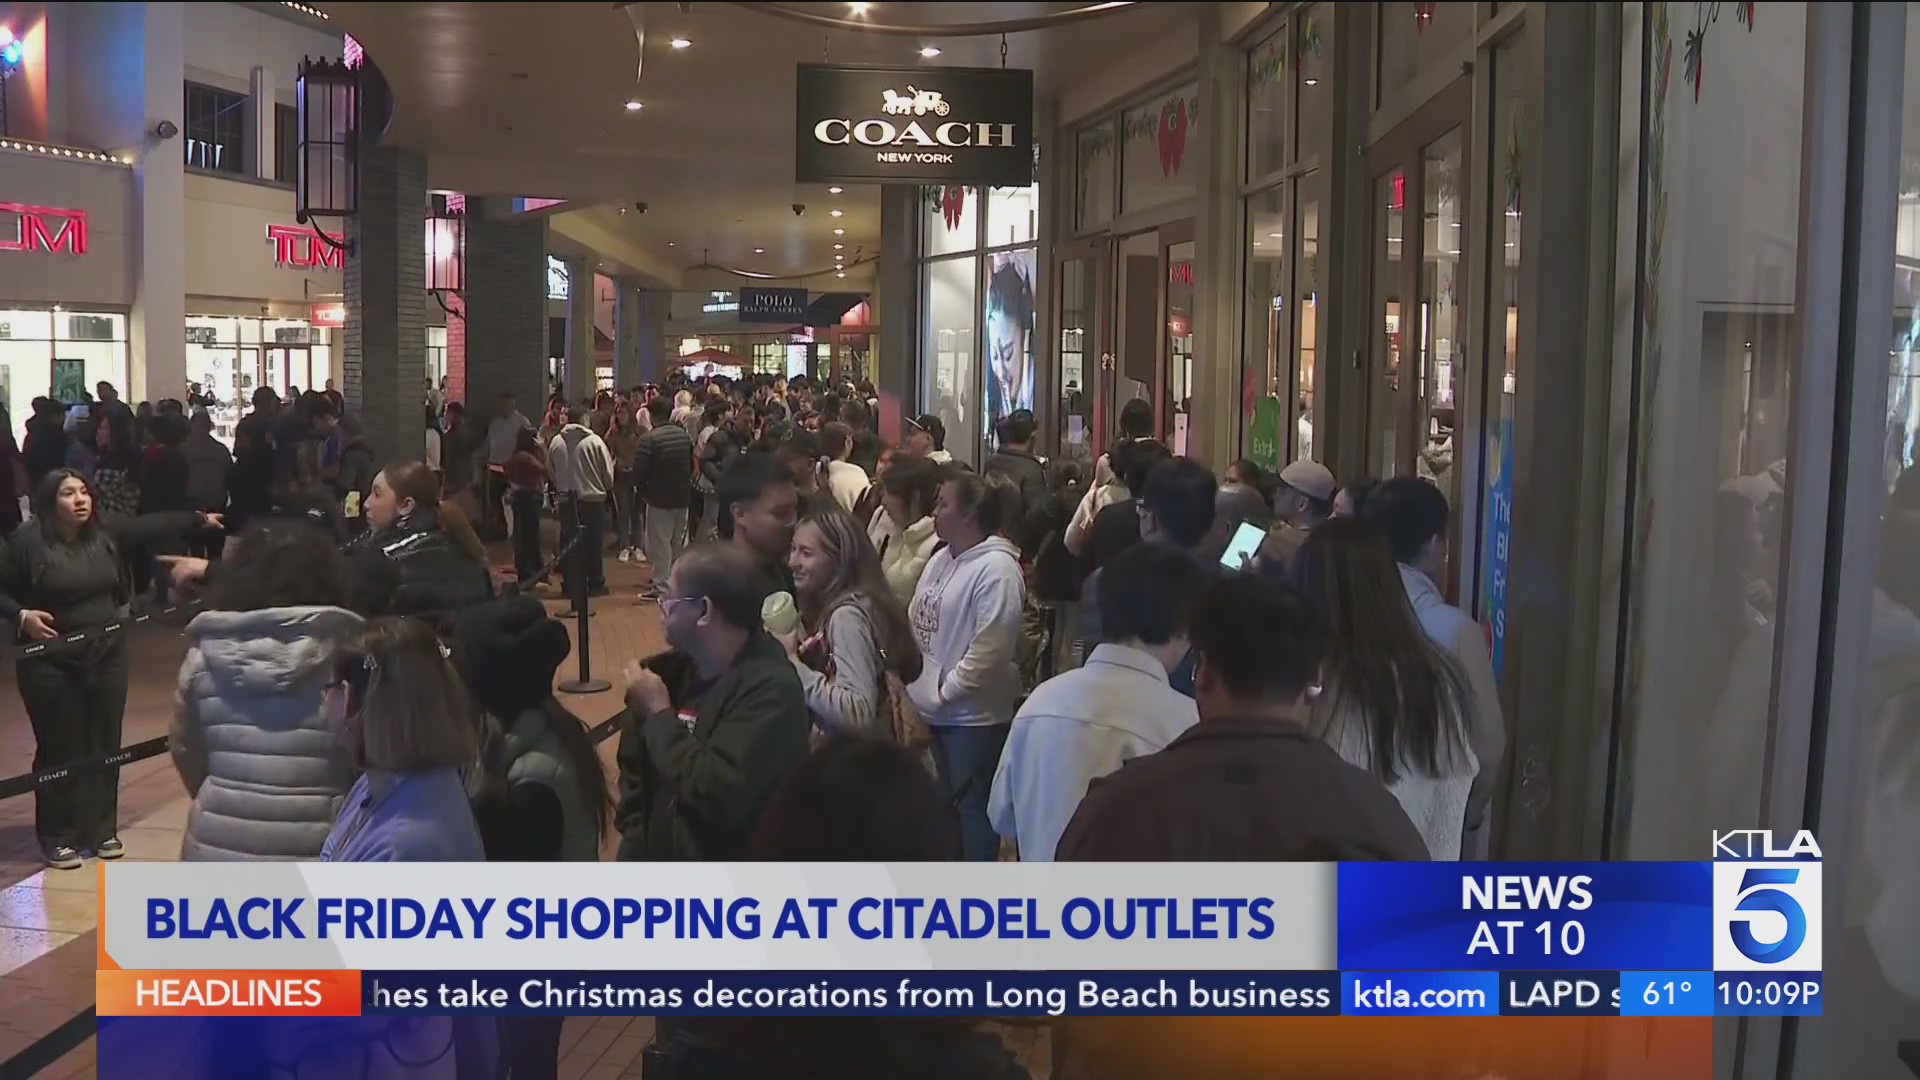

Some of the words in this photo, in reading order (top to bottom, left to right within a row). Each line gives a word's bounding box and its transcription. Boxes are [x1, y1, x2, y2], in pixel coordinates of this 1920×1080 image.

[814, 119, 1017, 147] COACH
[877, 152, 912, 164] NEW
[914, 153, 954, 164] YORK
[0, 202, 88, 255] UMI
[265, 223, 345, 269] TUM
[754, 294, 793, 306] POLO
[25, 645, 45, 653] COACH
[105, 752, 131, 764] COACH
[39, 770, 68, 782] COACH
